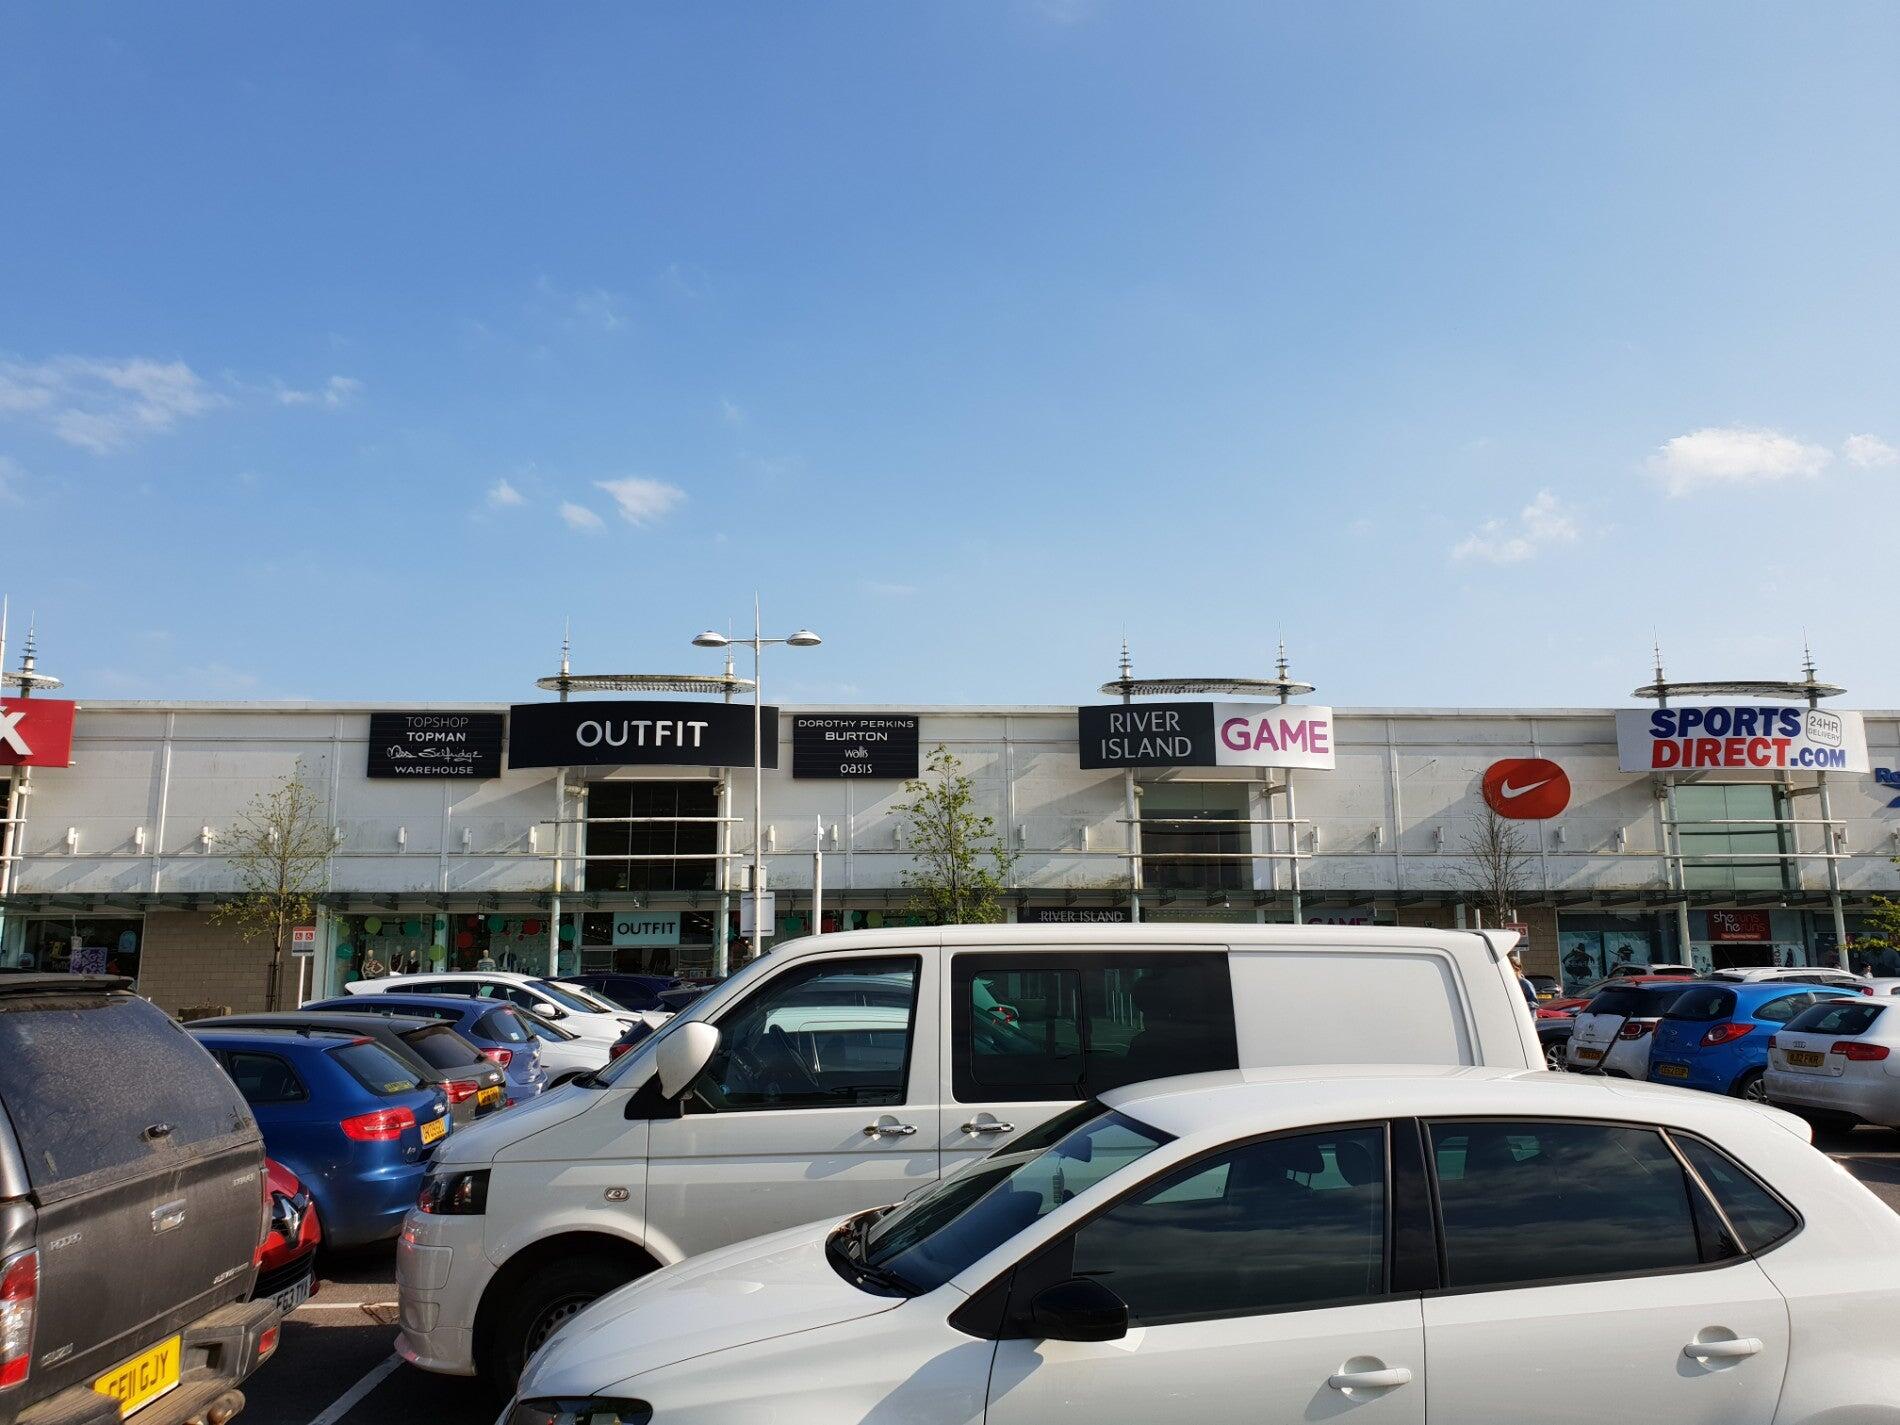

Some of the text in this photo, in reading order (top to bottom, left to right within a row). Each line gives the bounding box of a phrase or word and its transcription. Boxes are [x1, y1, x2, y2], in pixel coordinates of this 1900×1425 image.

[405, 716, 469, 728] TOPSHOP
[798, 720, 914, 728] DOROTHY PERKINS
[1109, 711, 1180, 734] RIVER
[1649, 706, 1802, 739] SPORTS
[1809, 714, 1839, 733] 24HR
[406, 732, 466, 742] TOPMAN
[576, 720, 709, 747] OUTFIT
[825, 731, 888, 741] BURTON
[1221, 717, 1329, 754] GAME
[1101, 736, 1192, 760] ISLAND
[394, 765, 474, 774] WAREHOUSE
[1040, 910, 1123, 923] RIVER ISLAND
[617, 922, 676, 936] OUTFIT
